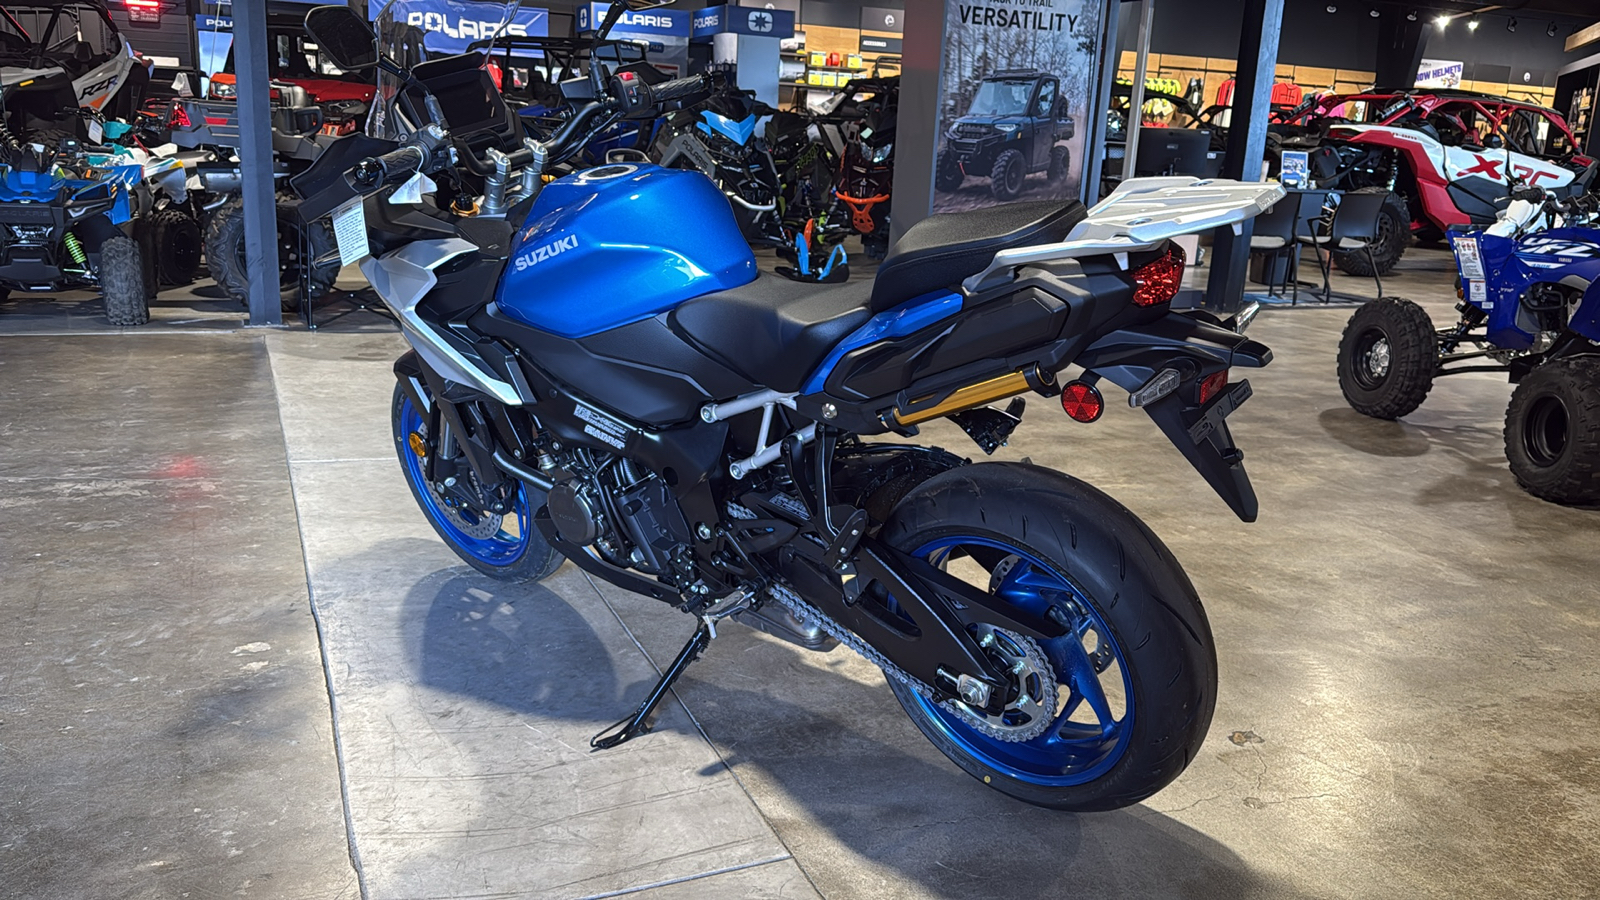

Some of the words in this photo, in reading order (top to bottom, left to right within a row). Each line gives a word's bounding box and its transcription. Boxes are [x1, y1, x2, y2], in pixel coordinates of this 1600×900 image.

[408, 12, 527, 39] POLARIS
[694, 15, 719, 29] POLARIS
[959, 5, 1078, 32] VERSATILITY
[1432, 64, 1462, 79] HELMETS
[79, 74, 118, 100] RZR
[682, 139, 709, 169] POLARIS
[515, 234, 579, 271] SUZUKI
